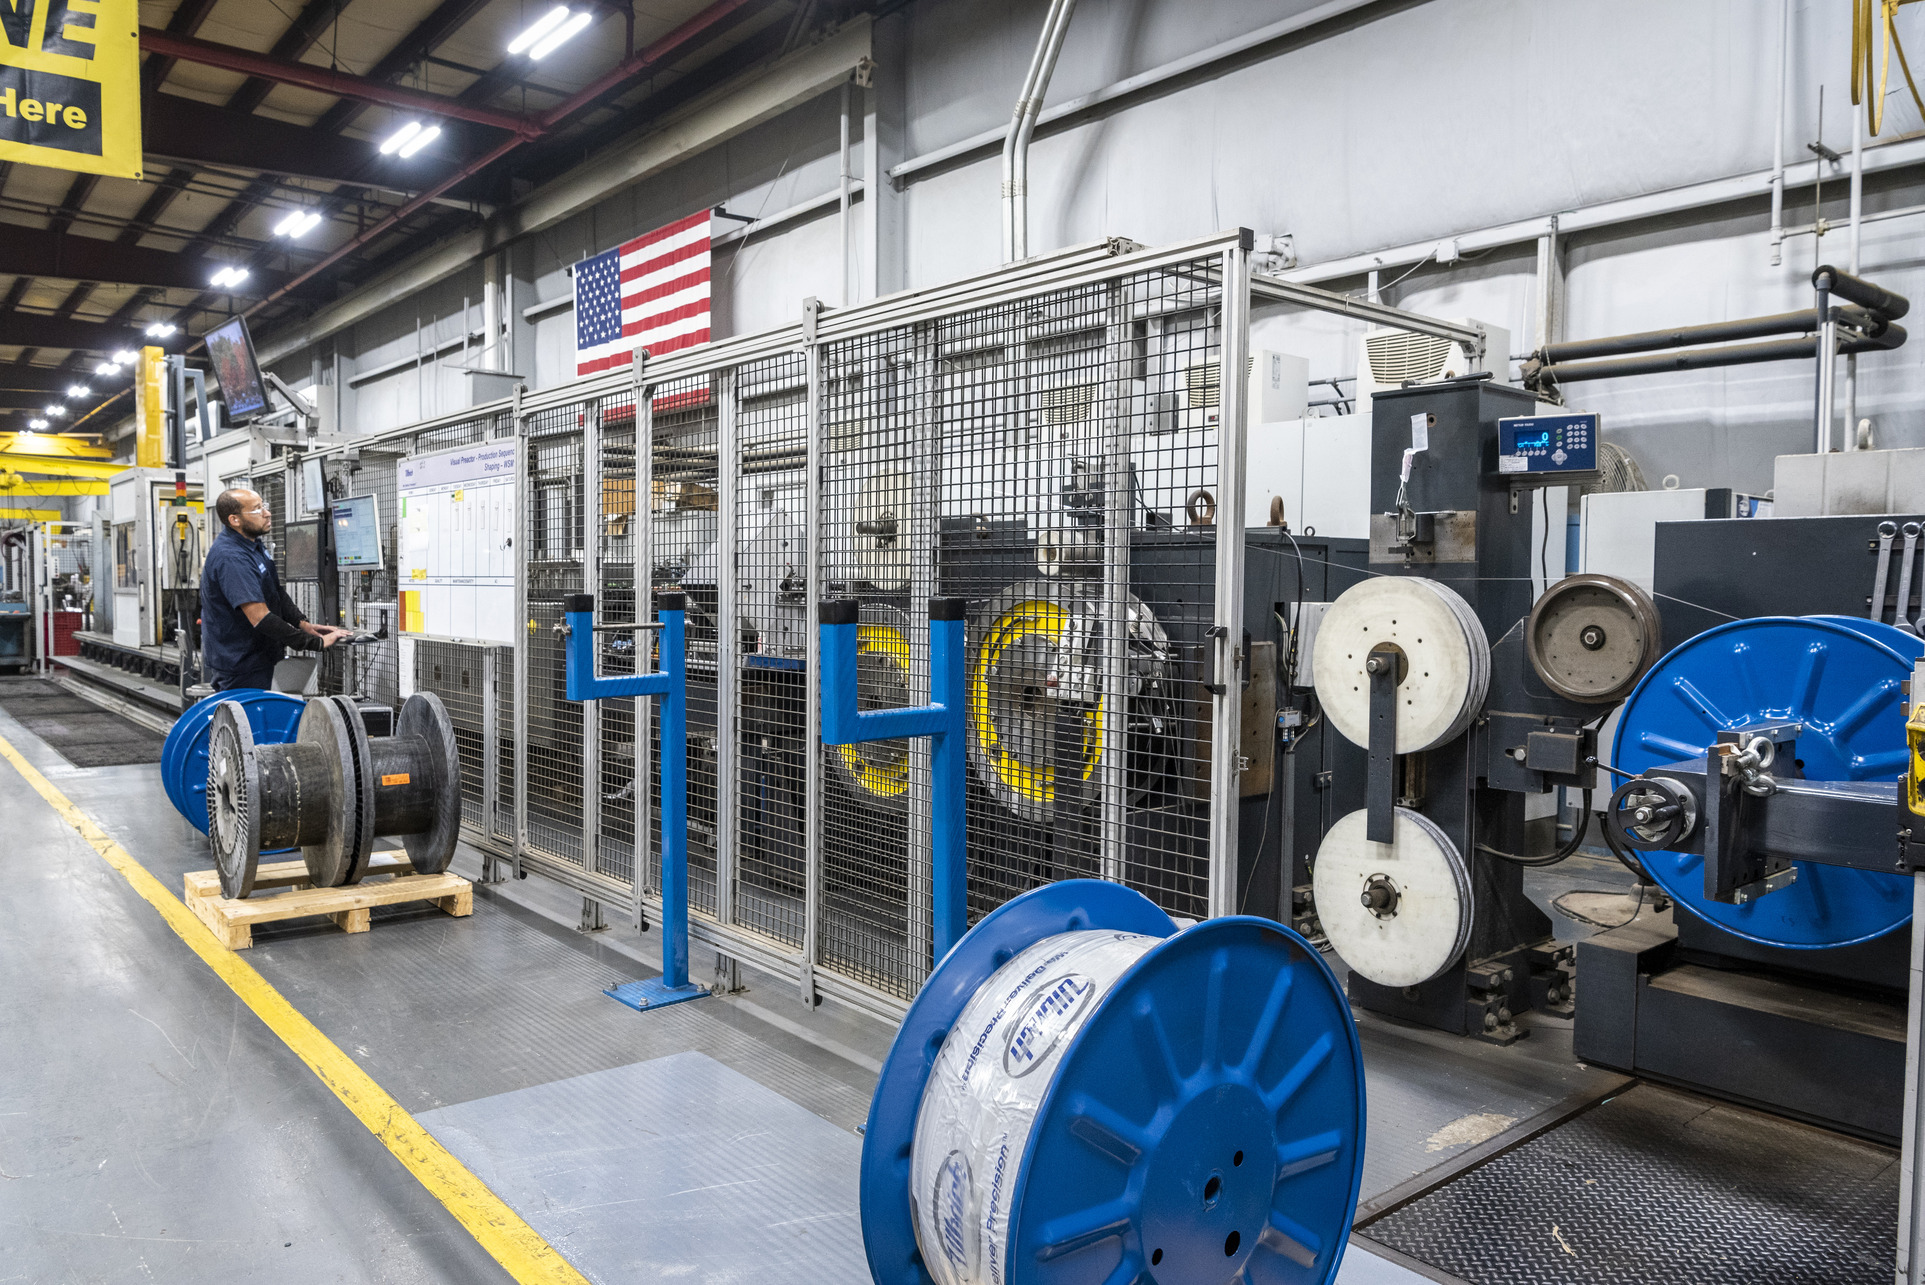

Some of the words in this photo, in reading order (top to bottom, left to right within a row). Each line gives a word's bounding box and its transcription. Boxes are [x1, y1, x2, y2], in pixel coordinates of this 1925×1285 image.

[0, 87, 88, 130] Here
[478, 451, 498, 461] Production
[484, 462, 500, 472] Shaping
